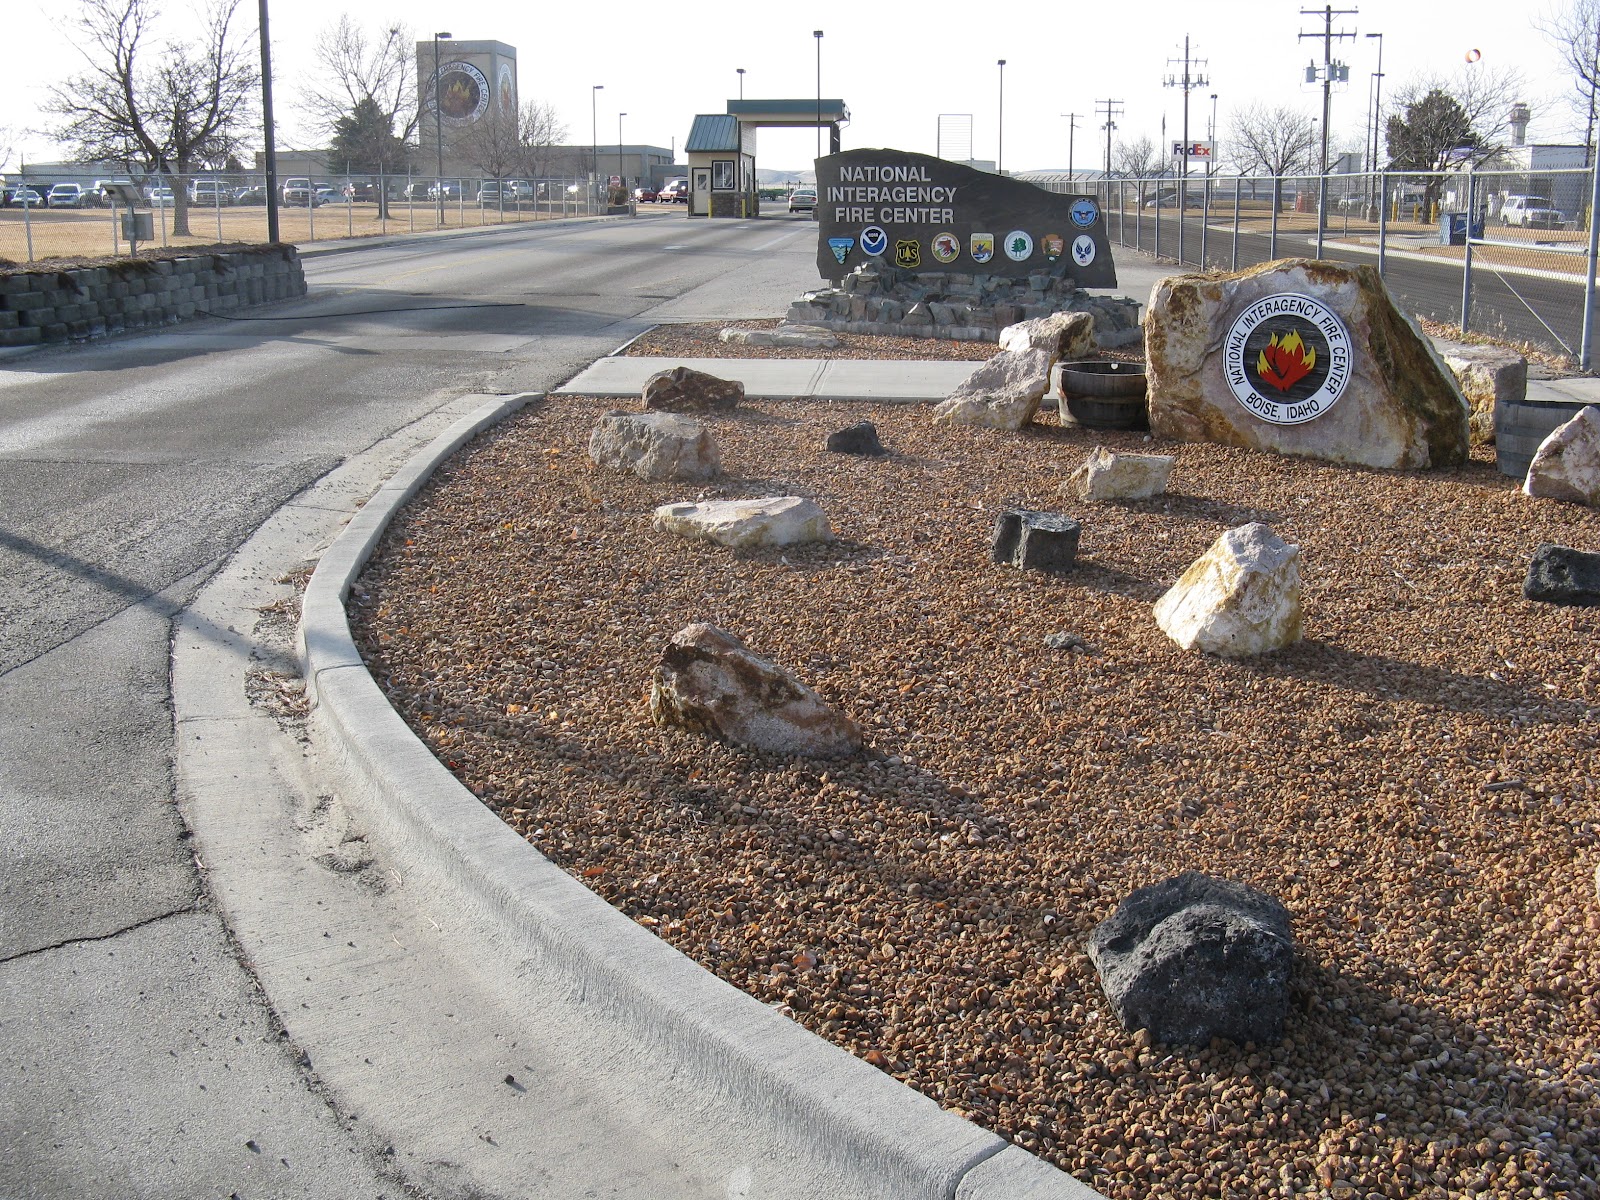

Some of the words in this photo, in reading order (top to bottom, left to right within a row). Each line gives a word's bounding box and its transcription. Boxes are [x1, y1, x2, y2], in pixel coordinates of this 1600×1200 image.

[1173, 143, 1211, 156] FedEx
[840, 166, 932, 182] NATIONAL
[827, 186, 957, 203] INTERAGENCY
[835, 207, 875, 223] FIRE
[880, 207, 955, 224] CENTER
[1242, 299, 1321, 329] INTERAGENCY
[1319, 316, 1342, 343] FIRE
[1228, 330, 1247, 386] NATIONAL
[1325, 346, 1346, 395] CENTER
[1245, 392, 1280, 420] BOISE,
[1286, 399, 1320, 419] IDAHO
